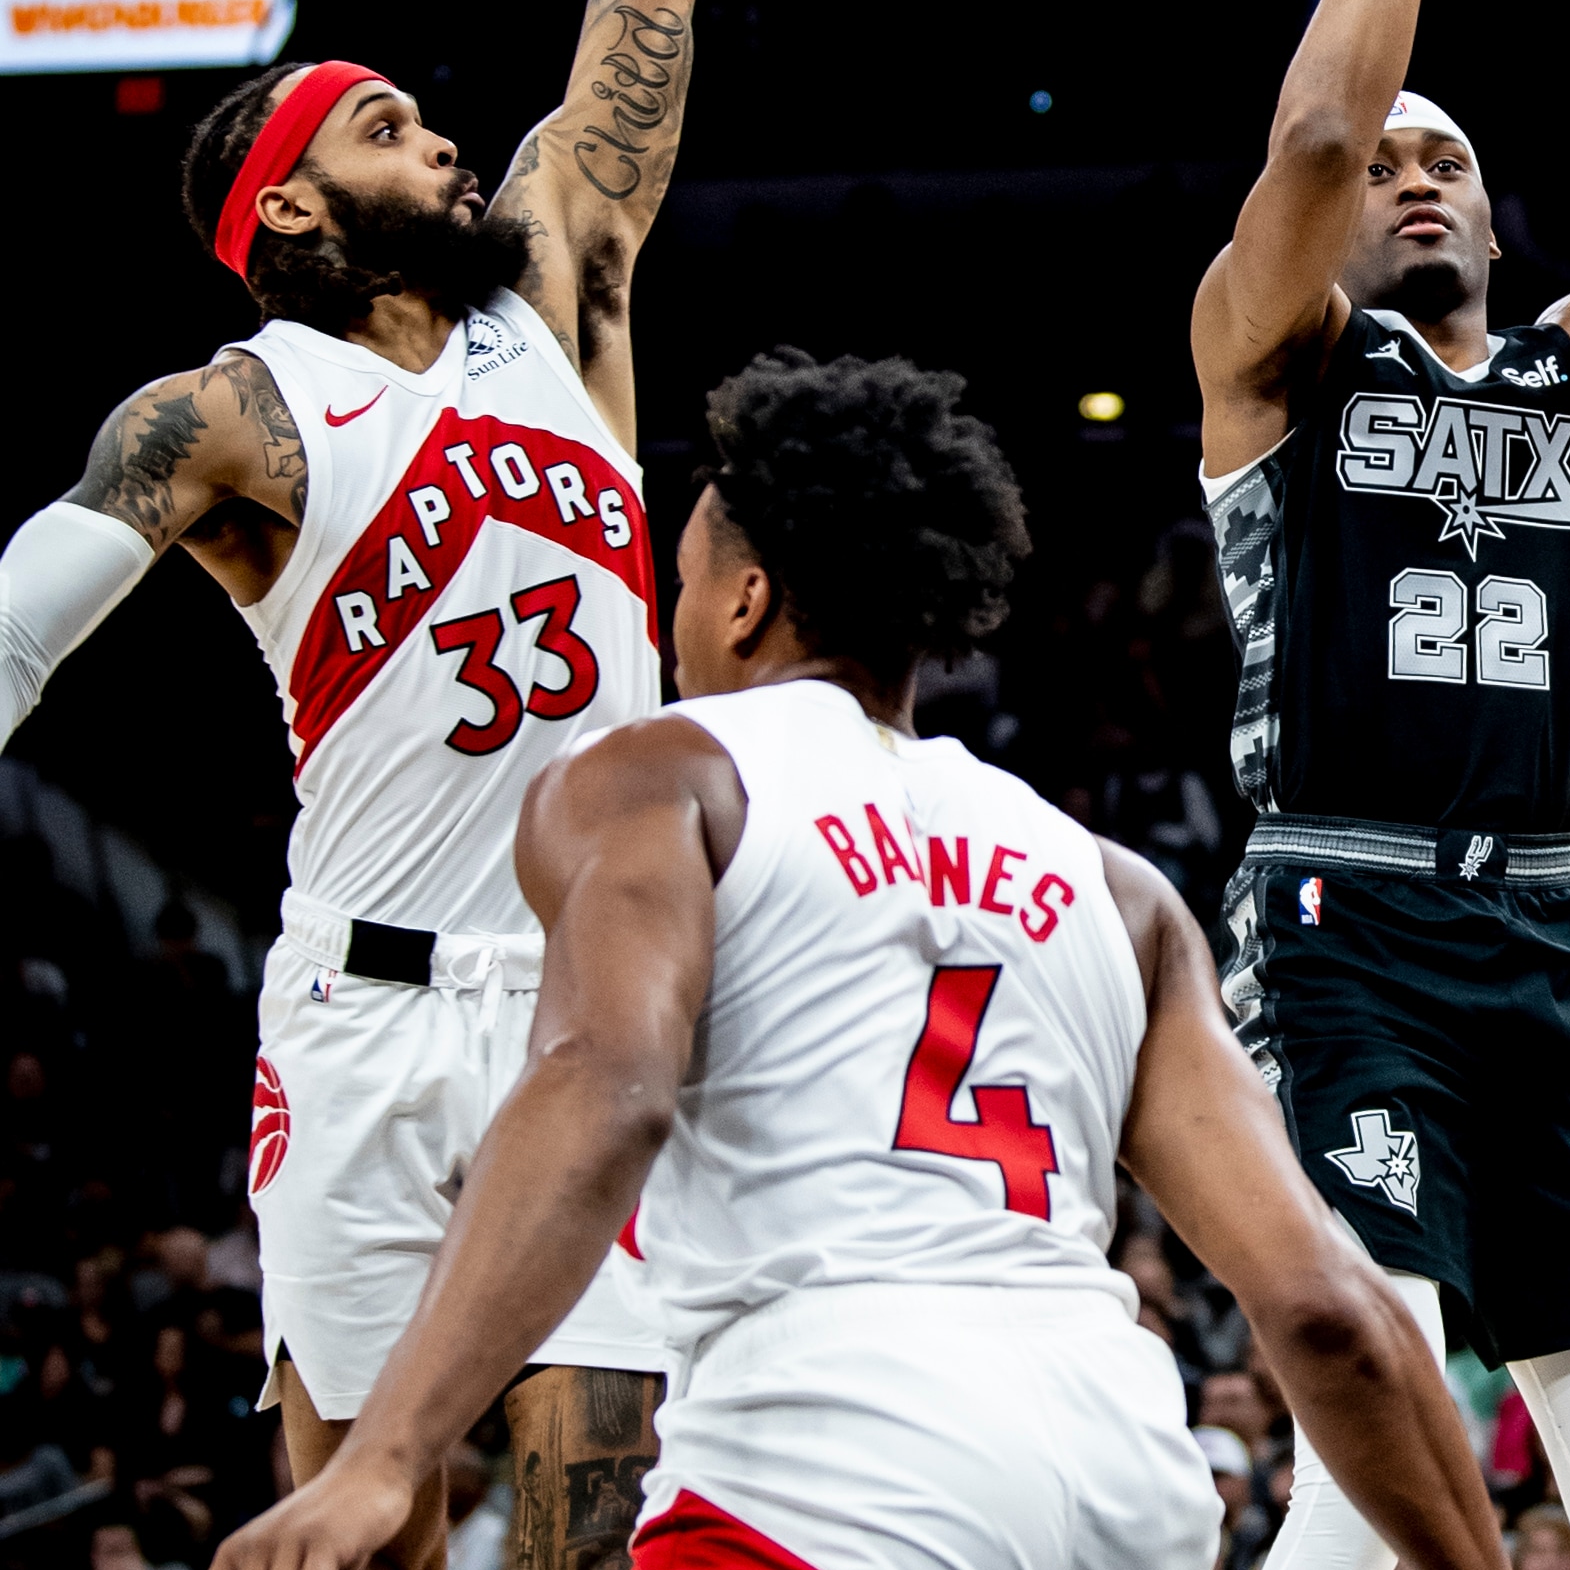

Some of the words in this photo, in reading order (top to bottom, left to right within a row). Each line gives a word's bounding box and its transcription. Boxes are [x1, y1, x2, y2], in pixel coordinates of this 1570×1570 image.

[467, 359, 500, 381] Sun
[497, 341, 529, 365] Life
[334, 441, 633, 654] RAPTORS
[429, 573, 600, 757] 33
[1387, 567, 1551, 691] 22
[813, 802, 1076, 943] BANES
[891, 963, 1061, 1223] 4
